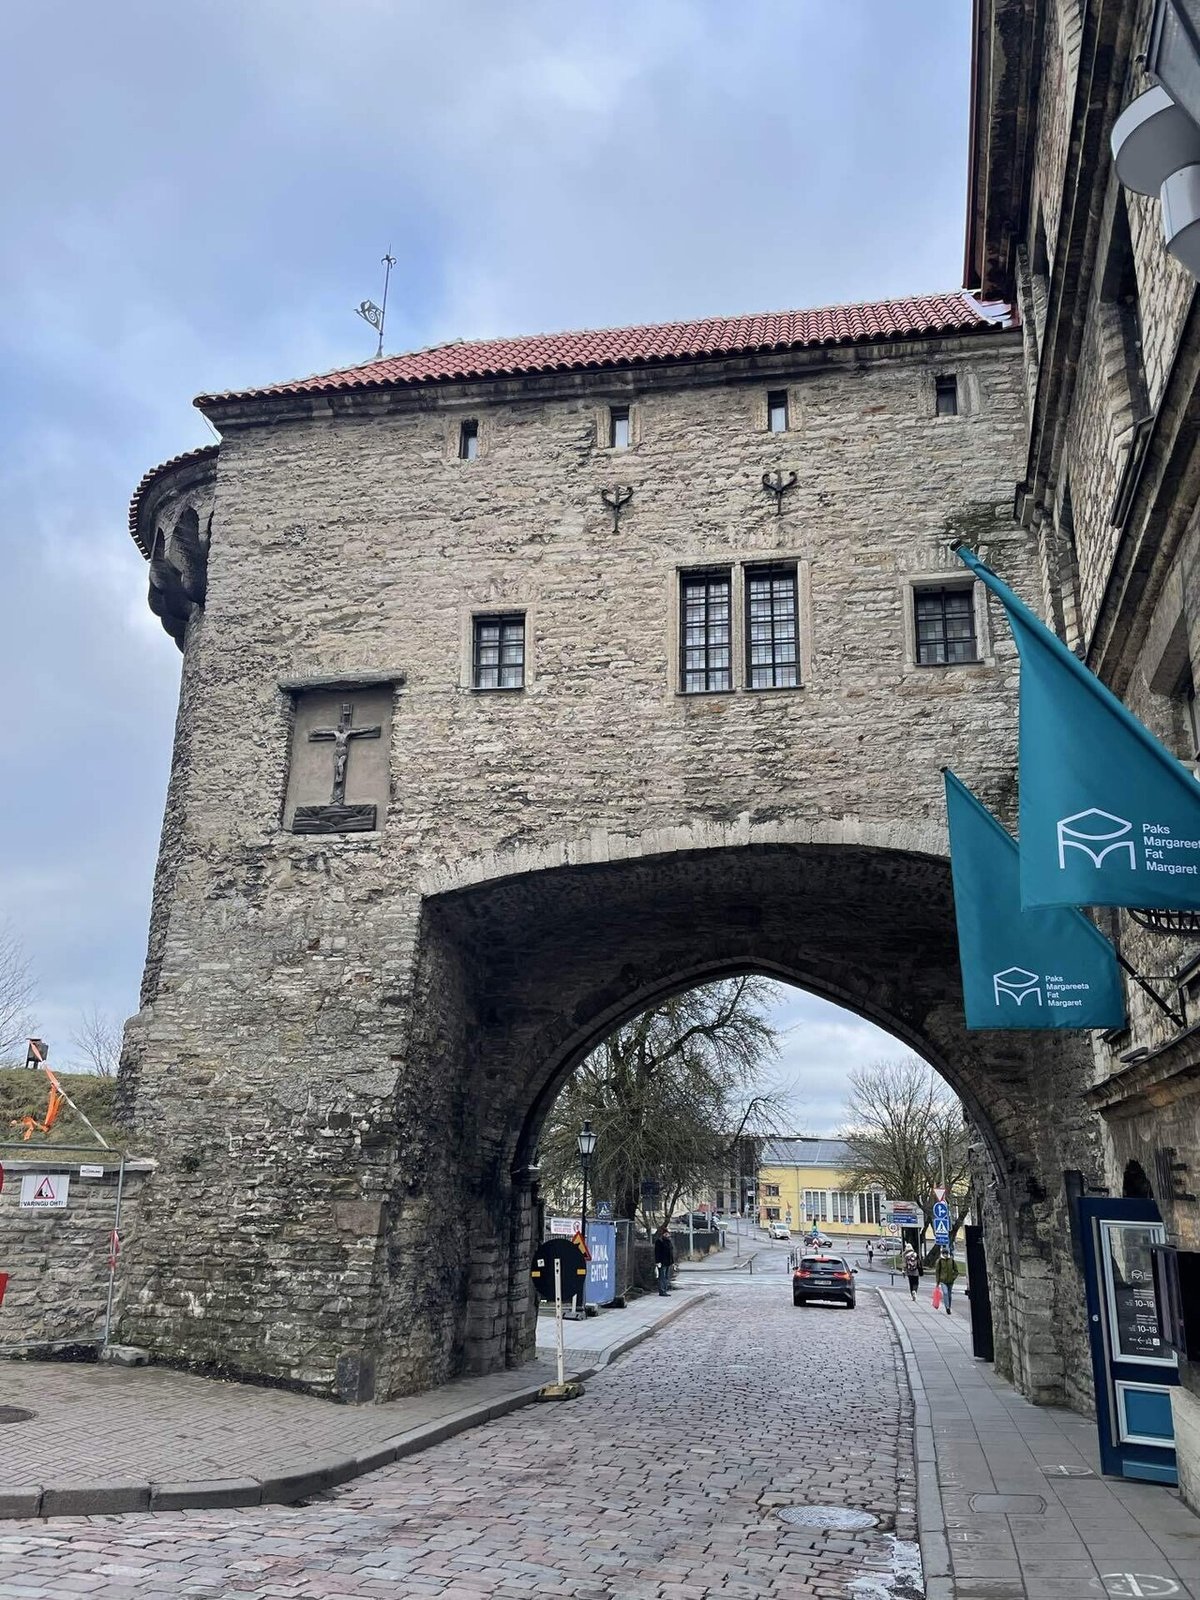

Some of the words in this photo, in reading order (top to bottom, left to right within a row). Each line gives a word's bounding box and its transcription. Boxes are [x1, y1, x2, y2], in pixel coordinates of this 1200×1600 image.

[1142, 823, 1170, 834] Paks
[1145, 848, 1164, 859] Fat
[1146, 860, 1198, 874] Margaret
[1046, 983, 1089, 991] Margareeta
[1048, 999, 1082, 1007] Margaret
[1137, 1325, 1157, 1333] 10-18
